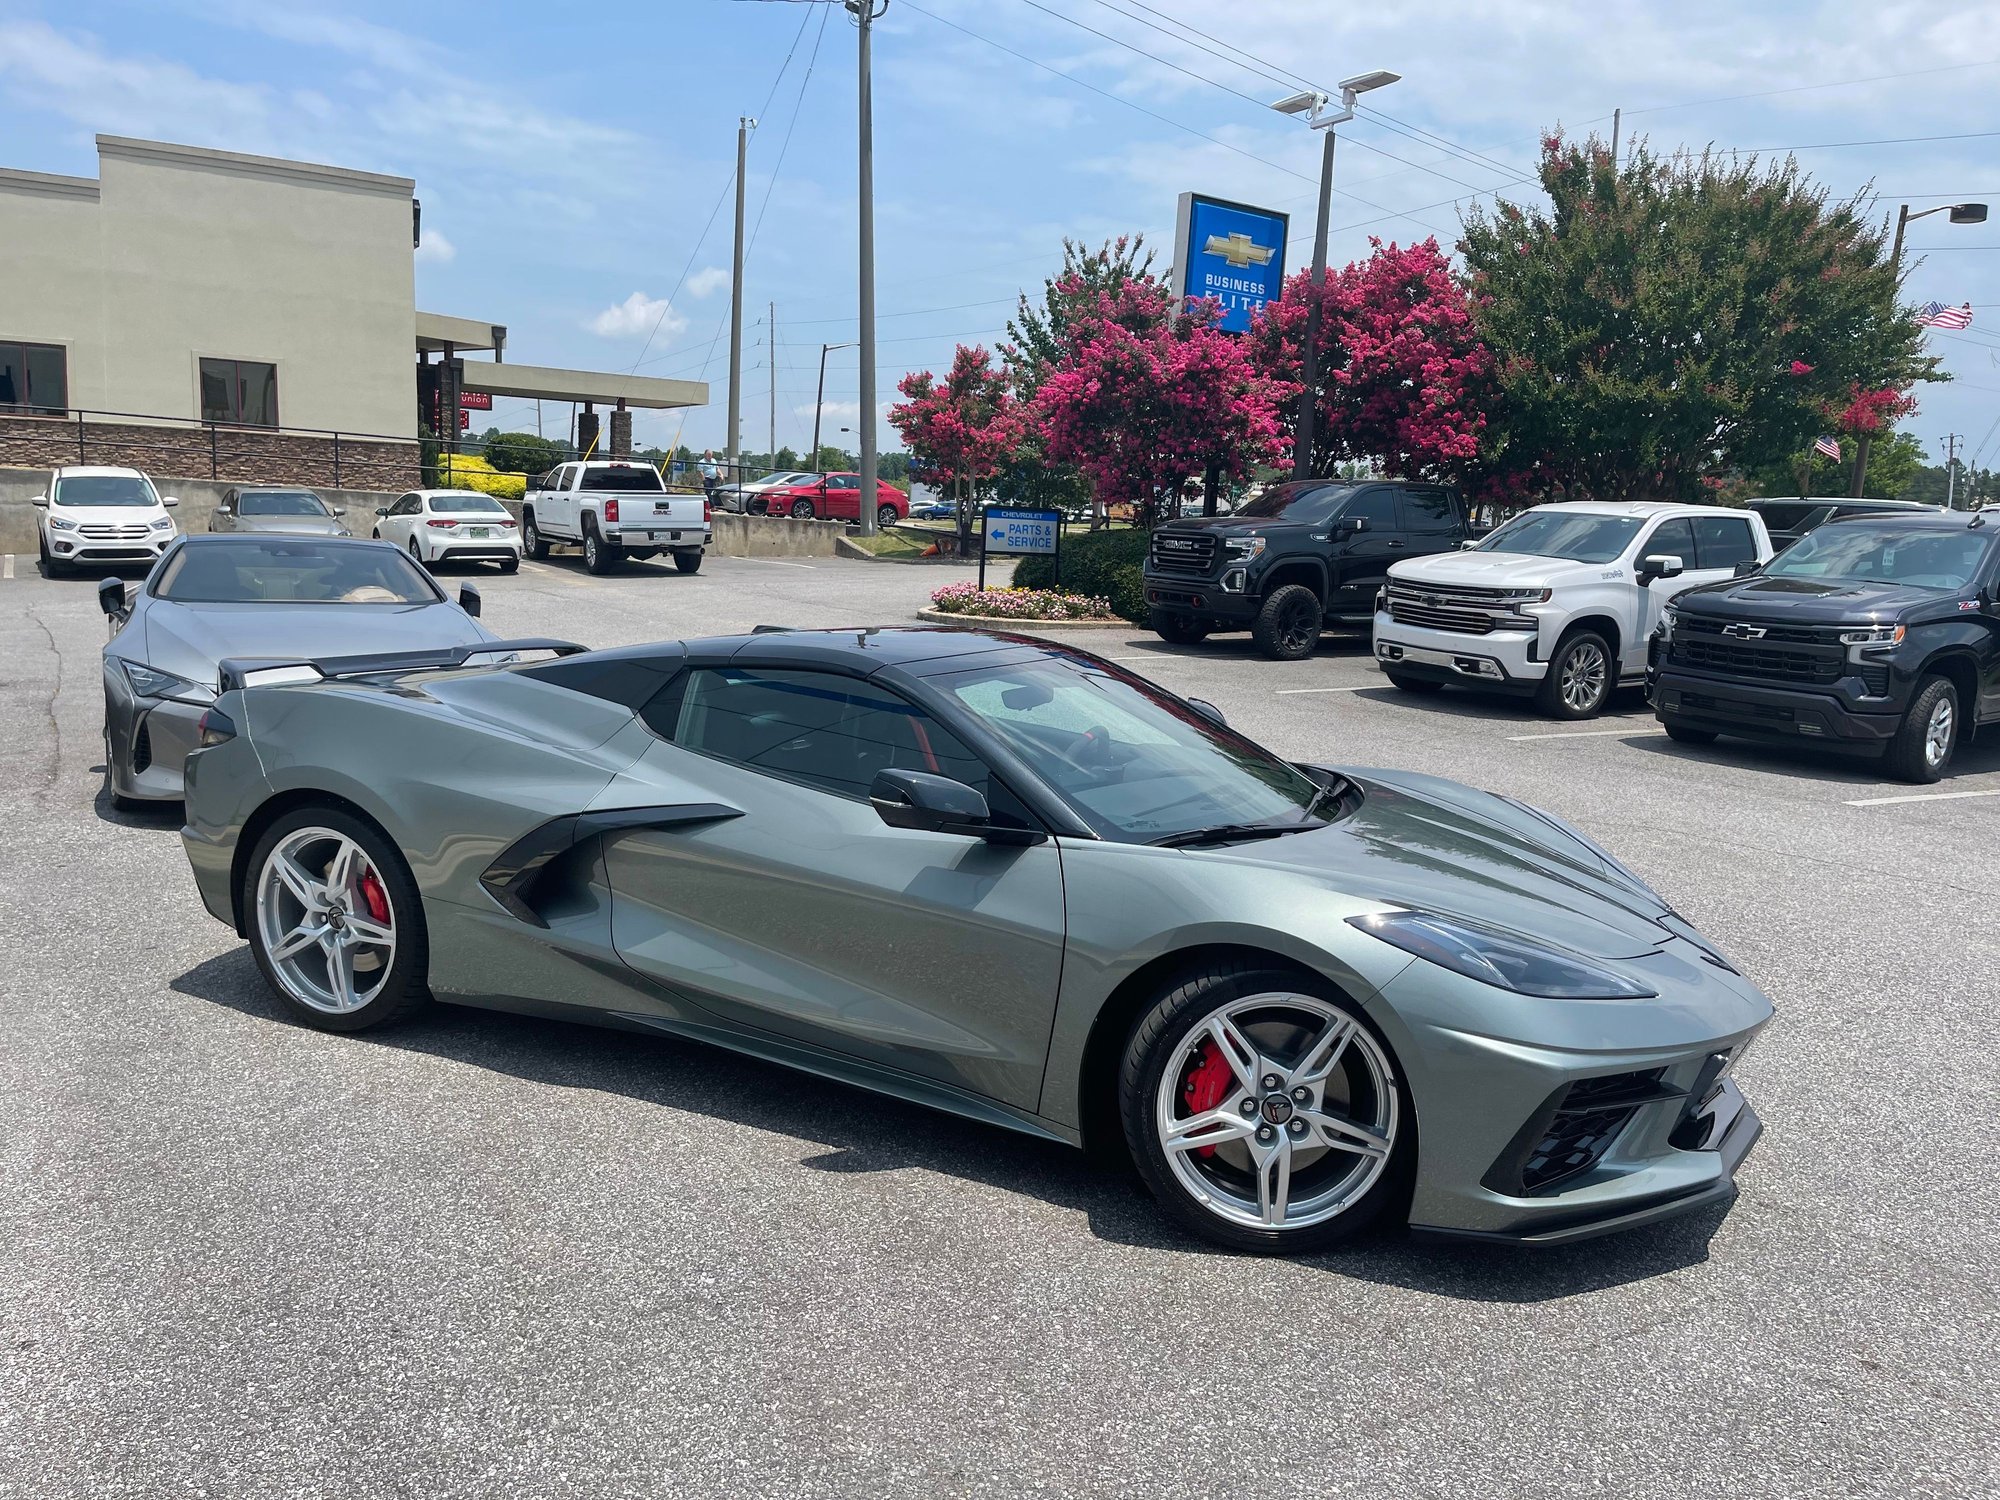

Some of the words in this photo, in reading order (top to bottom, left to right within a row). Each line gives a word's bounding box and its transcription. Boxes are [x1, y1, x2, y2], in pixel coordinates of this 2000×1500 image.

[1205, 273, 1265, 295] BUSINESS
[461, 395, 488, 403] union
[1001, 511, 1043, 519] CHEVROLET
[1008, 523, 1042, 536] PARTS
[1044, 525, 1052, 536] &
[1007, 536, 1052, 548] SERVICE
[1163, 540, 1192, 549] GMC
